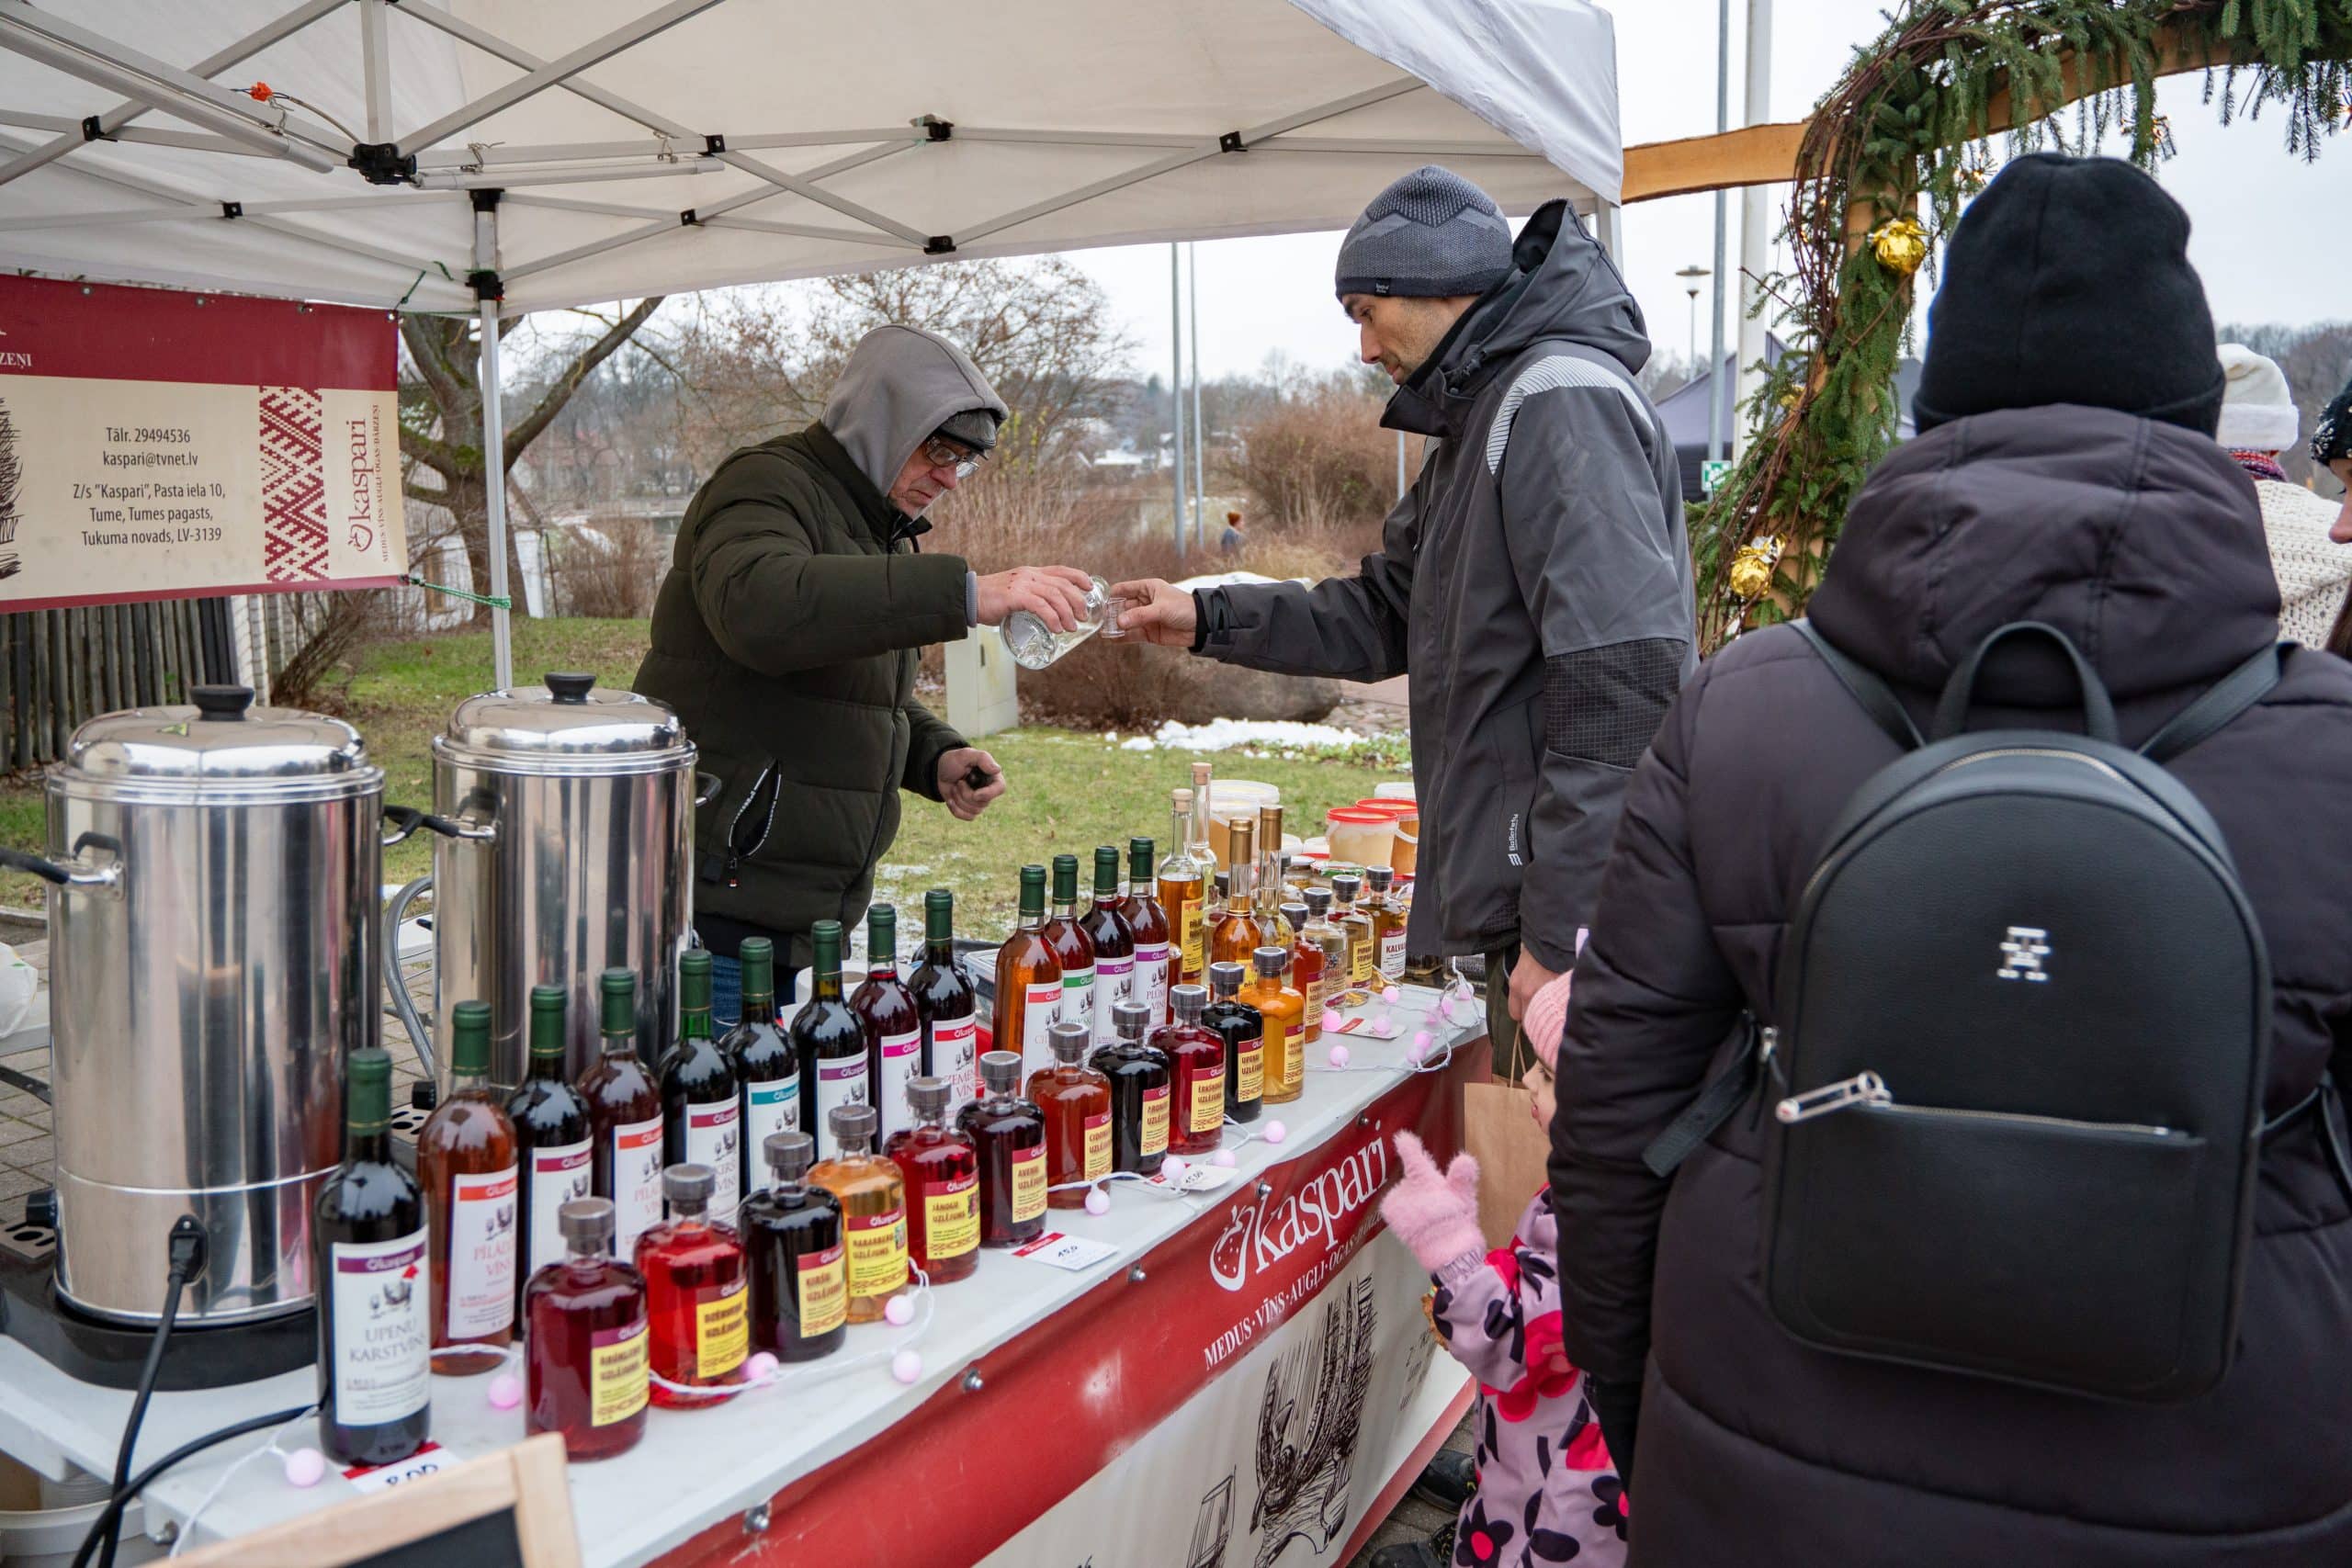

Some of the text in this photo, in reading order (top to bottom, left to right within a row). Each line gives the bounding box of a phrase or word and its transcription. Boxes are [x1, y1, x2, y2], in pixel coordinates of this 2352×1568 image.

[106, 427, 190, 443] Tālr. 29494536
[103, 451, 198, 468] kaspari@tvnet.lv
[346, 419, 374, 522] kaspari
[73, 483, 92, 499] Z/s
[154, 483, 184, 498] Pasta
[187, 483, 207, 498] iela
[210, 483, 226, 499] 10,
[89, 506, 213, 525] Tume, Tumes pagasts,
[82, 527, 221, 547] Tukuma novads, LV-3139
[1256, 1120, 1387, 1274] kaspari
[1204, 1316, 1252, 1371] MEDUS
[1254, 1292, 1286, 1325] VĪNS
